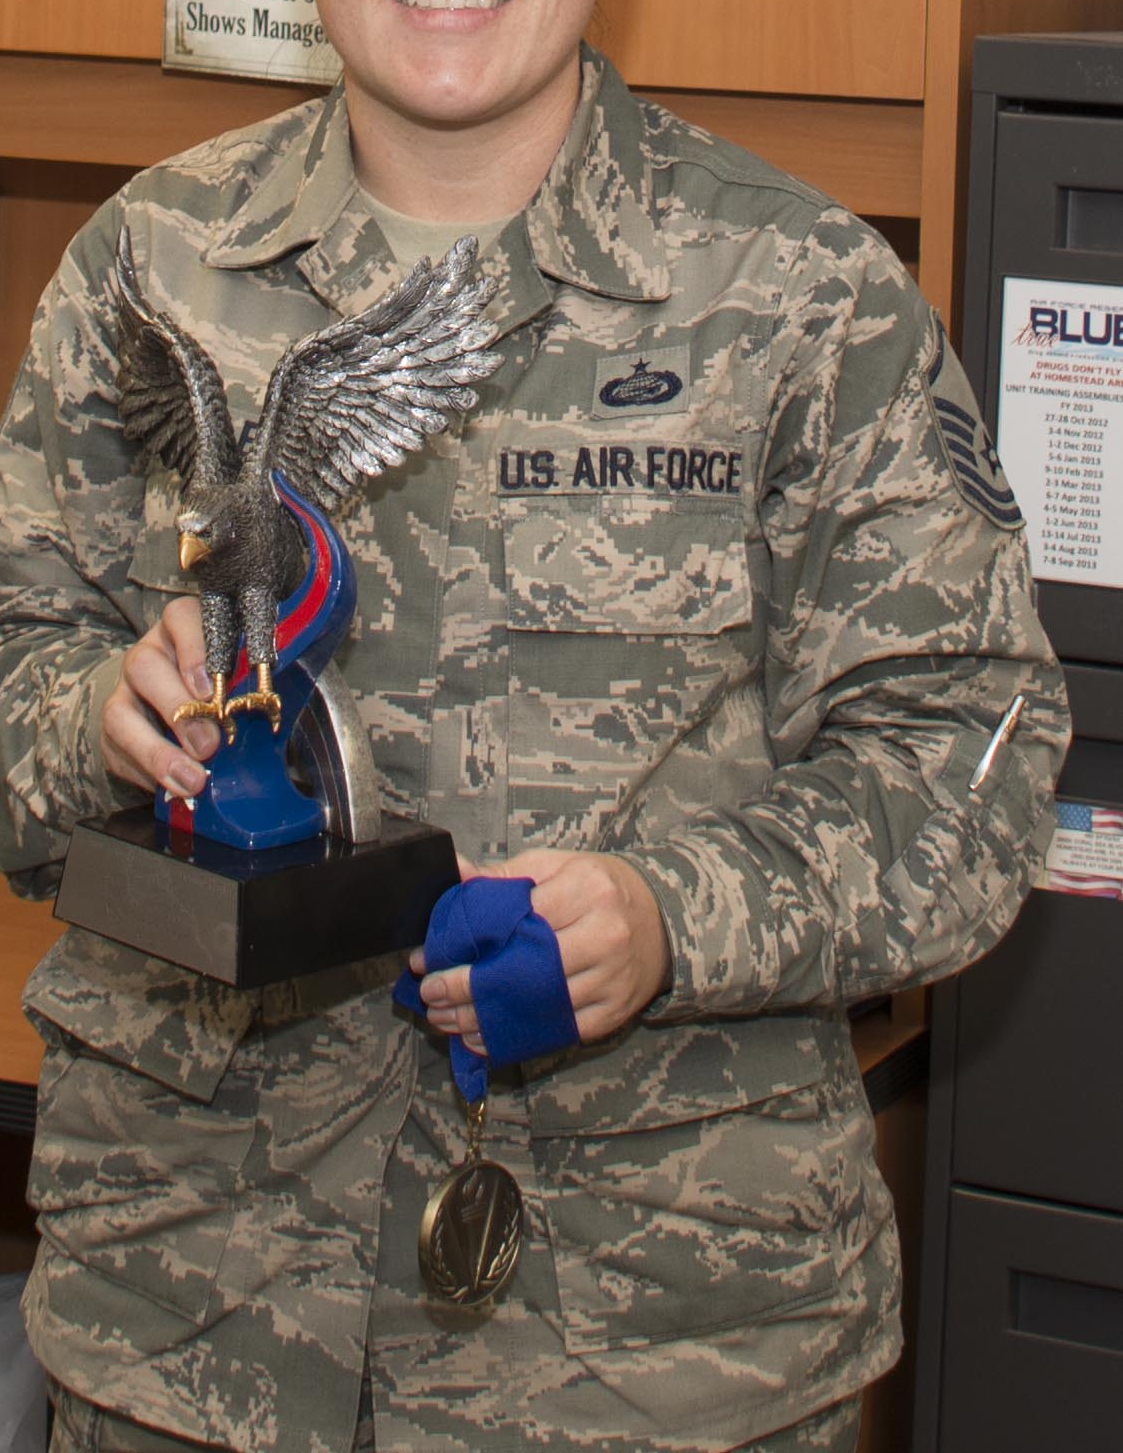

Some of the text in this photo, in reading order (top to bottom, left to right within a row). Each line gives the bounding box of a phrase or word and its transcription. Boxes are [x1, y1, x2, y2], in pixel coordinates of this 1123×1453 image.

[186, 1, 329, 48] Shows Manage
[1036, 361, 1121, 376] DRUGS DON'T FLY
[1030, 372, 1041, 380] AT
[1045, 372, 1104, 385] HOMESTEAD
[1006, 384, 1027, 393] UNIT
[1029, 386, 1071, 398] TRAINING
[1060, 401, 1094, 413] FY 2013
[1070, 416, 1085, 425] Oct
[1087, 418, 1108, 428] 2012
[1064, 428, 1080, 437] Nov
[1083, 430, 1104, 440] 2012
[1064, 441, 1080, 450] Dec
[1081, 443, 1103, 453] 2012
[1063, 454, 1078, 463] Jan
[1080, 456, 1101, 466] 2013
[500, 446, 742, 493] U.S. AIR FORCE
[1065, 467, 1081, 476] Feb
[1083, 469, 1104, 479] 2013
[1061, 480, 1078, 489] Mar
[1081, 482, 1102, 491] 2013
[1062, 493, 1076, 502] Apr
[1079, 495, 1100, 504] 2013
[1059, 505, 1078, 516] May
[1080, 508, 1101, 517] 2013
[1061, 518, 1075, 527] Jun
[1078, 521, 1098, 530] 2013
[1067, 532, 1078, 541] Jul
[1080, 534, 1101, 544] 2013
[1059, 545, 1075, 555] Aug
[1078, 547, 1098, 557] 2013
[1058, 557, 1074, 567] Sep
[1076, 559, 1097, 569] 2013
